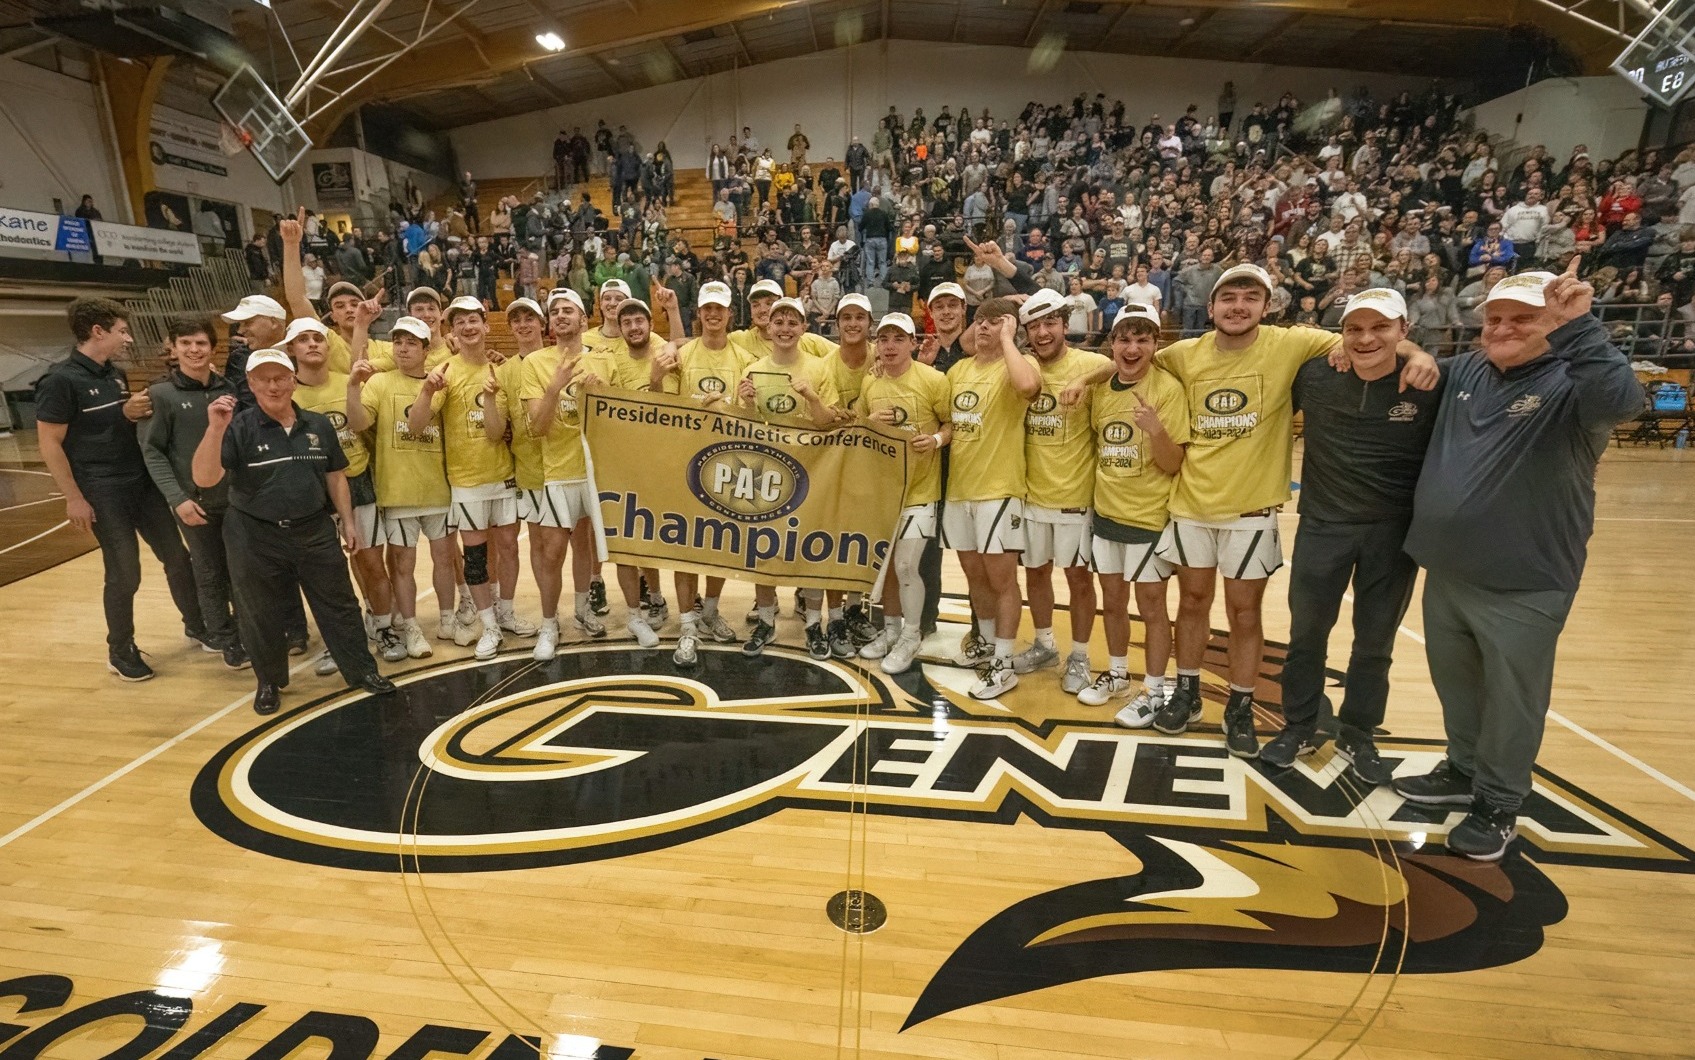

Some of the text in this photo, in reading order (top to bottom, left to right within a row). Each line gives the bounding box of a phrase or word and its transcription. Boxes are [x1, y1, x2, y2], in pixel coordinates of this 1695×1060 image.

[1213, 395, 1237, 408] PAC
[595, 400, 897, 458] Presidents' Athletic Conference
[1106, 427, 1128, 440] PAC
[1197, 412, 1258, 432] CHAMPIONS
[763, 448, 801, 479] ATHLETIC
[713, 462, 782, 502] PAC
[708, 500, 783, 521] CONFERENCE
[598, 491, 892, 572] Champions
